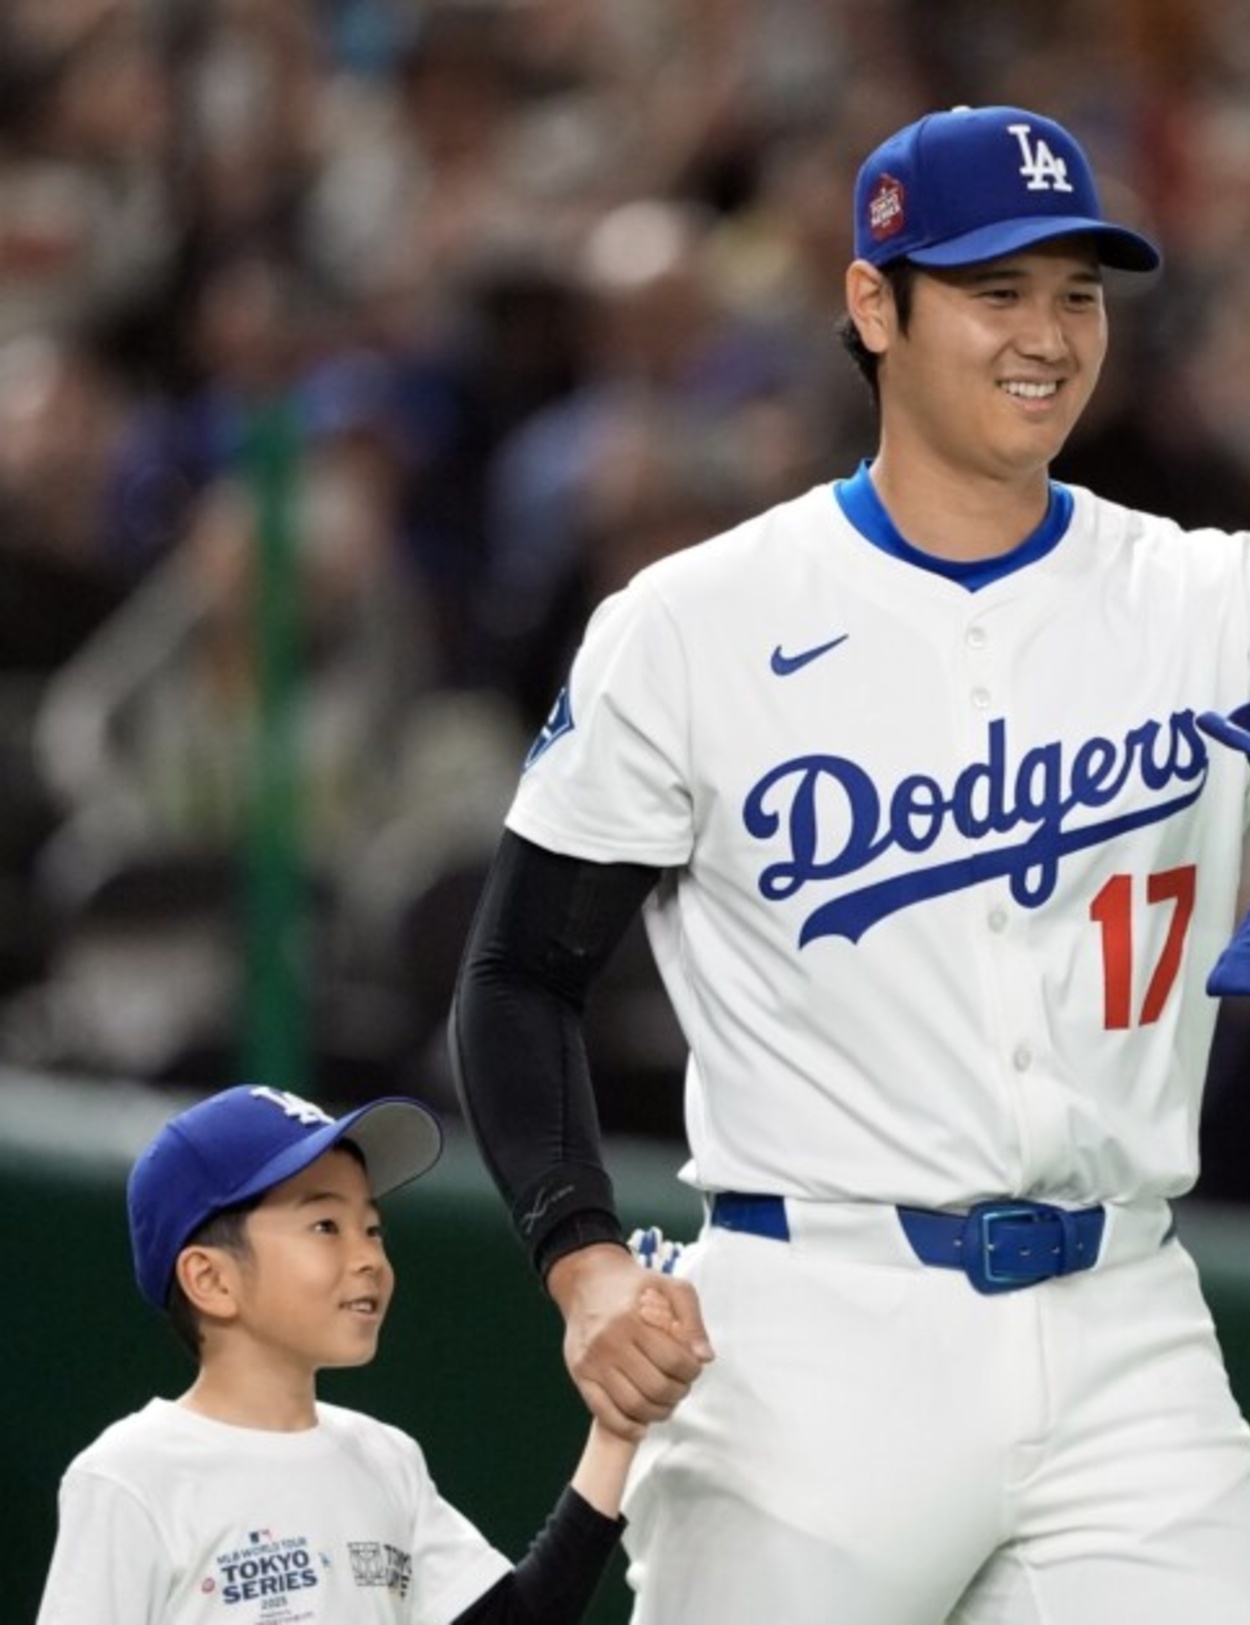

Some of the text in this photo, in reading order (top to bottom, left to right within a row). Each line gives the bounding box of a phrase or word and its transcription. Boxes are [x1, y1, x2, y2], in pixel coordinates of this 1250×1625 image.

[1007, 124, 1073, 192] LA
[743, 708, 1208, 909] Dodgers
[1090, 864, 1197, 1030] 17
[220, 1549, 310, 1583] TOKYO
[222, 1568, 318, 1605] SERIES
